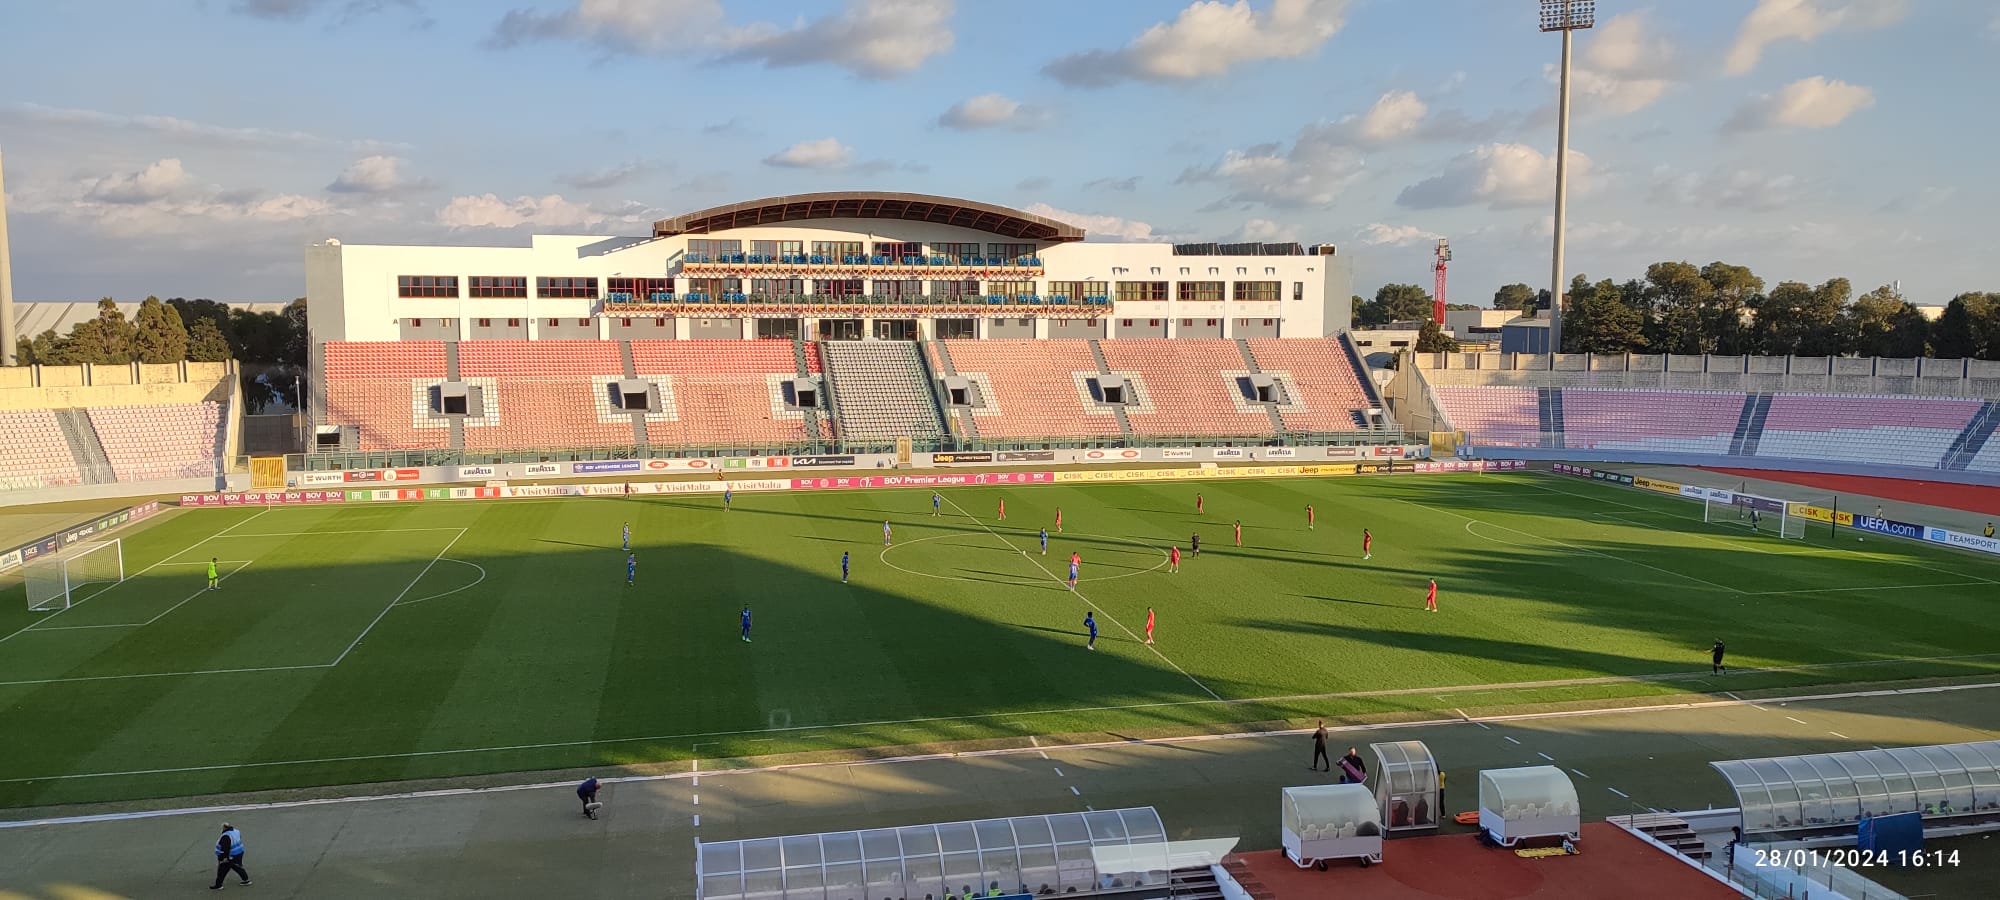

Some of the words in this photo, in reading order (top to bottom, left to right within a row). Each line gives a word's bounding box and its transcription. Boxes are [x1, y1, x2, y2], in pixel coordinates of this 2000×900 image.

[934, 454, 954, 463] Jeep
[1360, 464, 1377, 473] Jeep
[1635, 477, 1650, 487] Jeep
[521, 488, 568, 496] VisitMalta
[1799, 507, 1818, 516] CISK
[1860, 516, 1916, 536] UEFA.com
[66, 532, 78, 542] Jeep
[1948, 534, 1997, 549] TEAMSPORT
